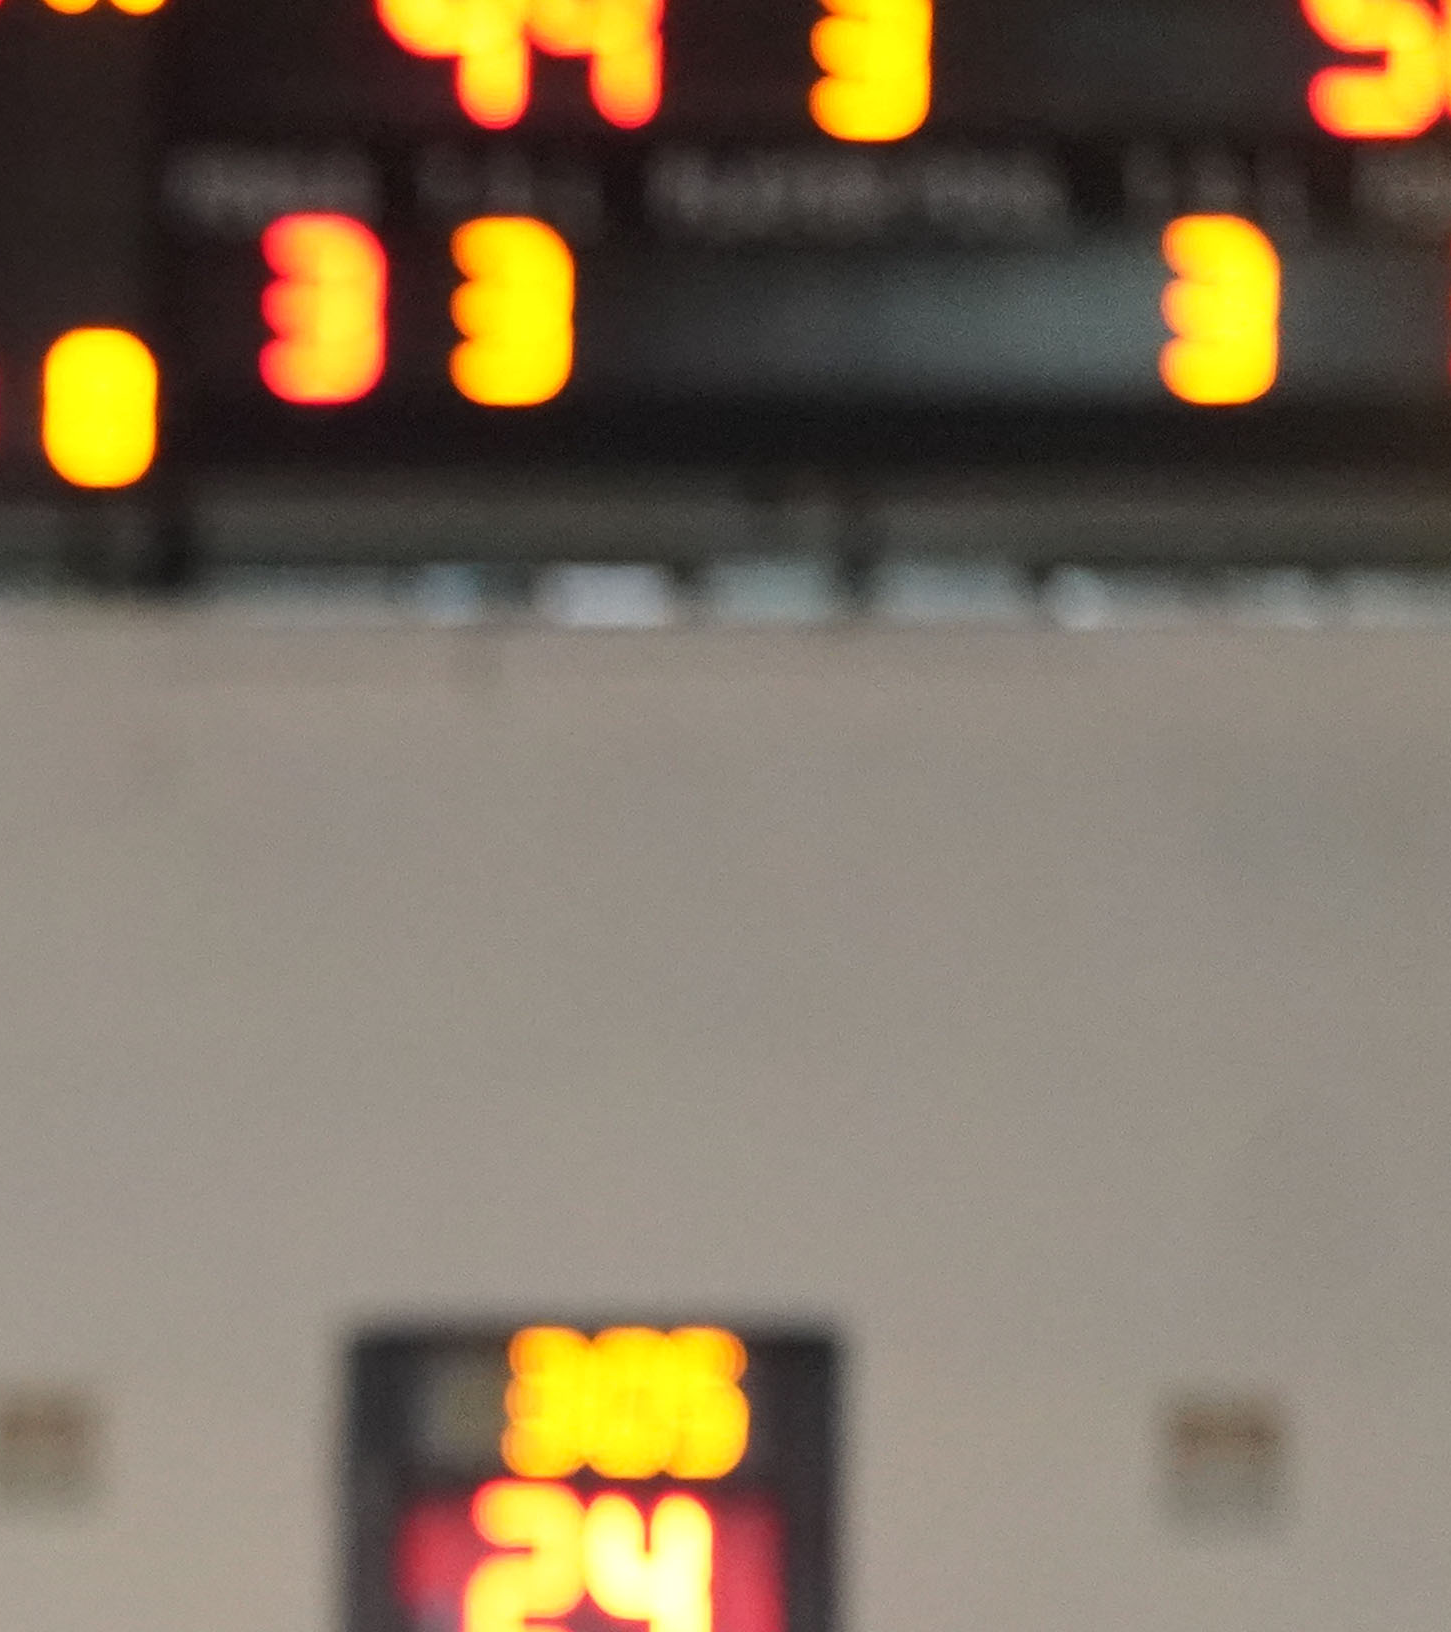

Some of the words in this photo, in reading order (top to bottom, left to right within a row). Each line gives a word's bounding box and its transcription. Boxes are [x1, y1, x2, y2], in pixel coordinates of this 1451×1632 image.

[259, 212, 389, 405] 3
[449, 215, 575, 407] 3
[1159, 213, 1283, 406] 3
